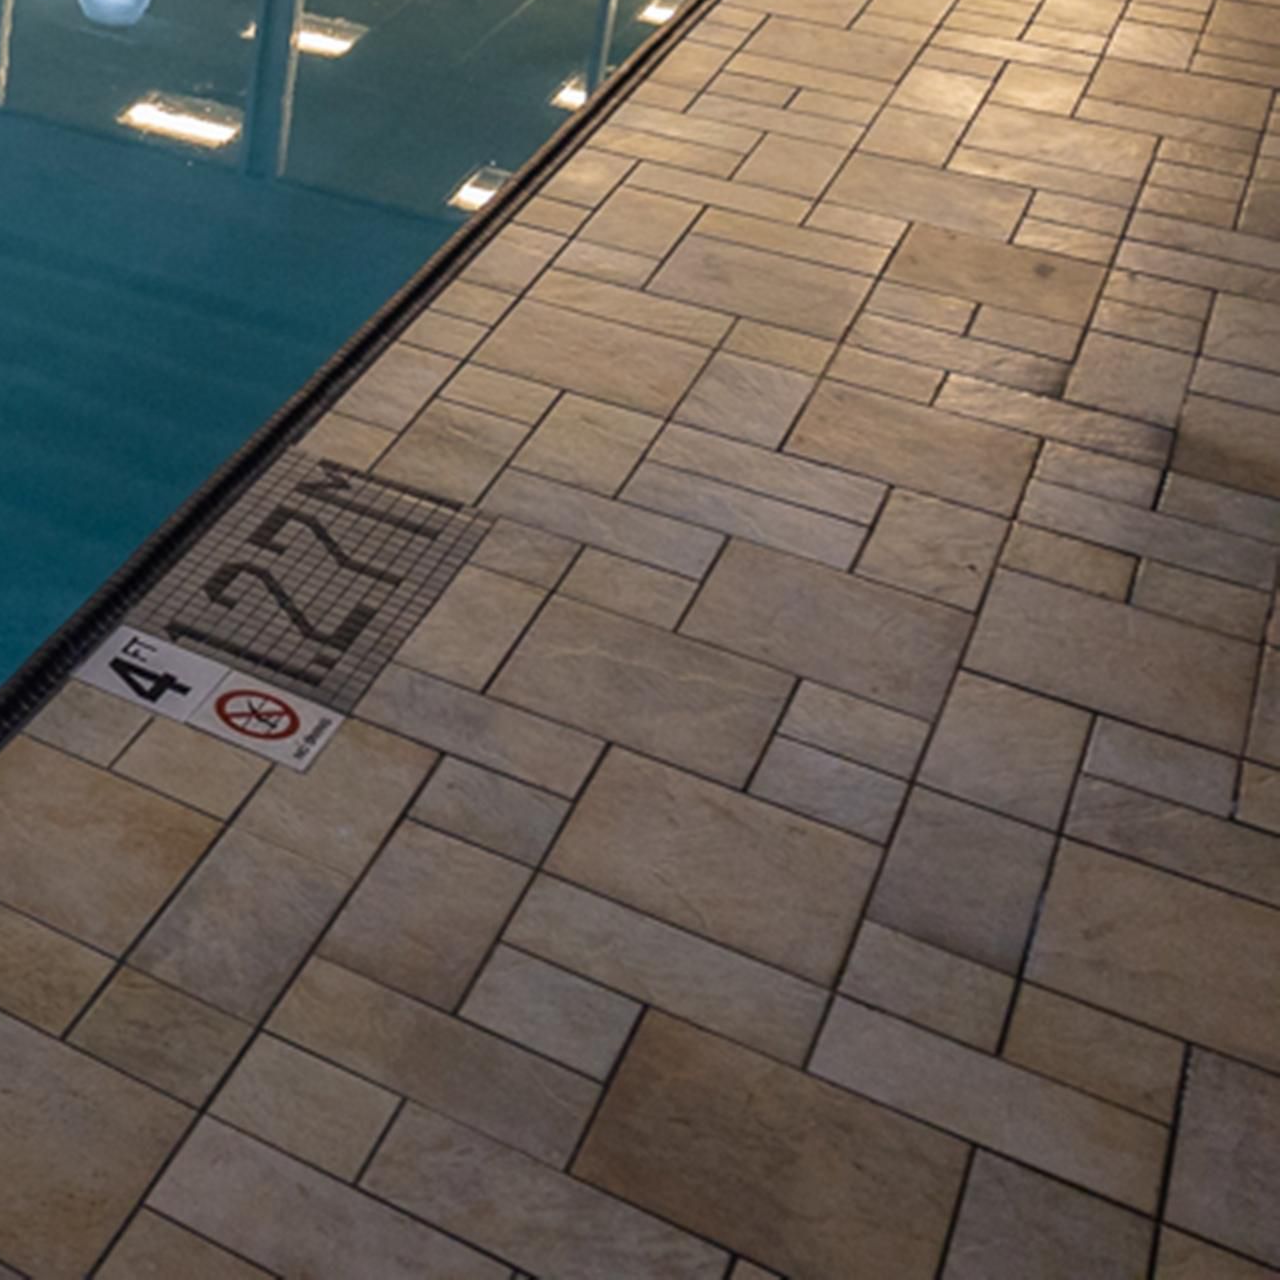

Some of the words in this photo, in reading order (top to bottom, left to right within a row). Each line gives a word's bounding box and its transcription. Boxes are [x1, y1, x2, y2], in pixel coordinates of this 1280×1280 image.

[163, 458, 467, 688] 1.27M
[121, 635, 158, 663] FT
[107, 656, 193, 704] 4
